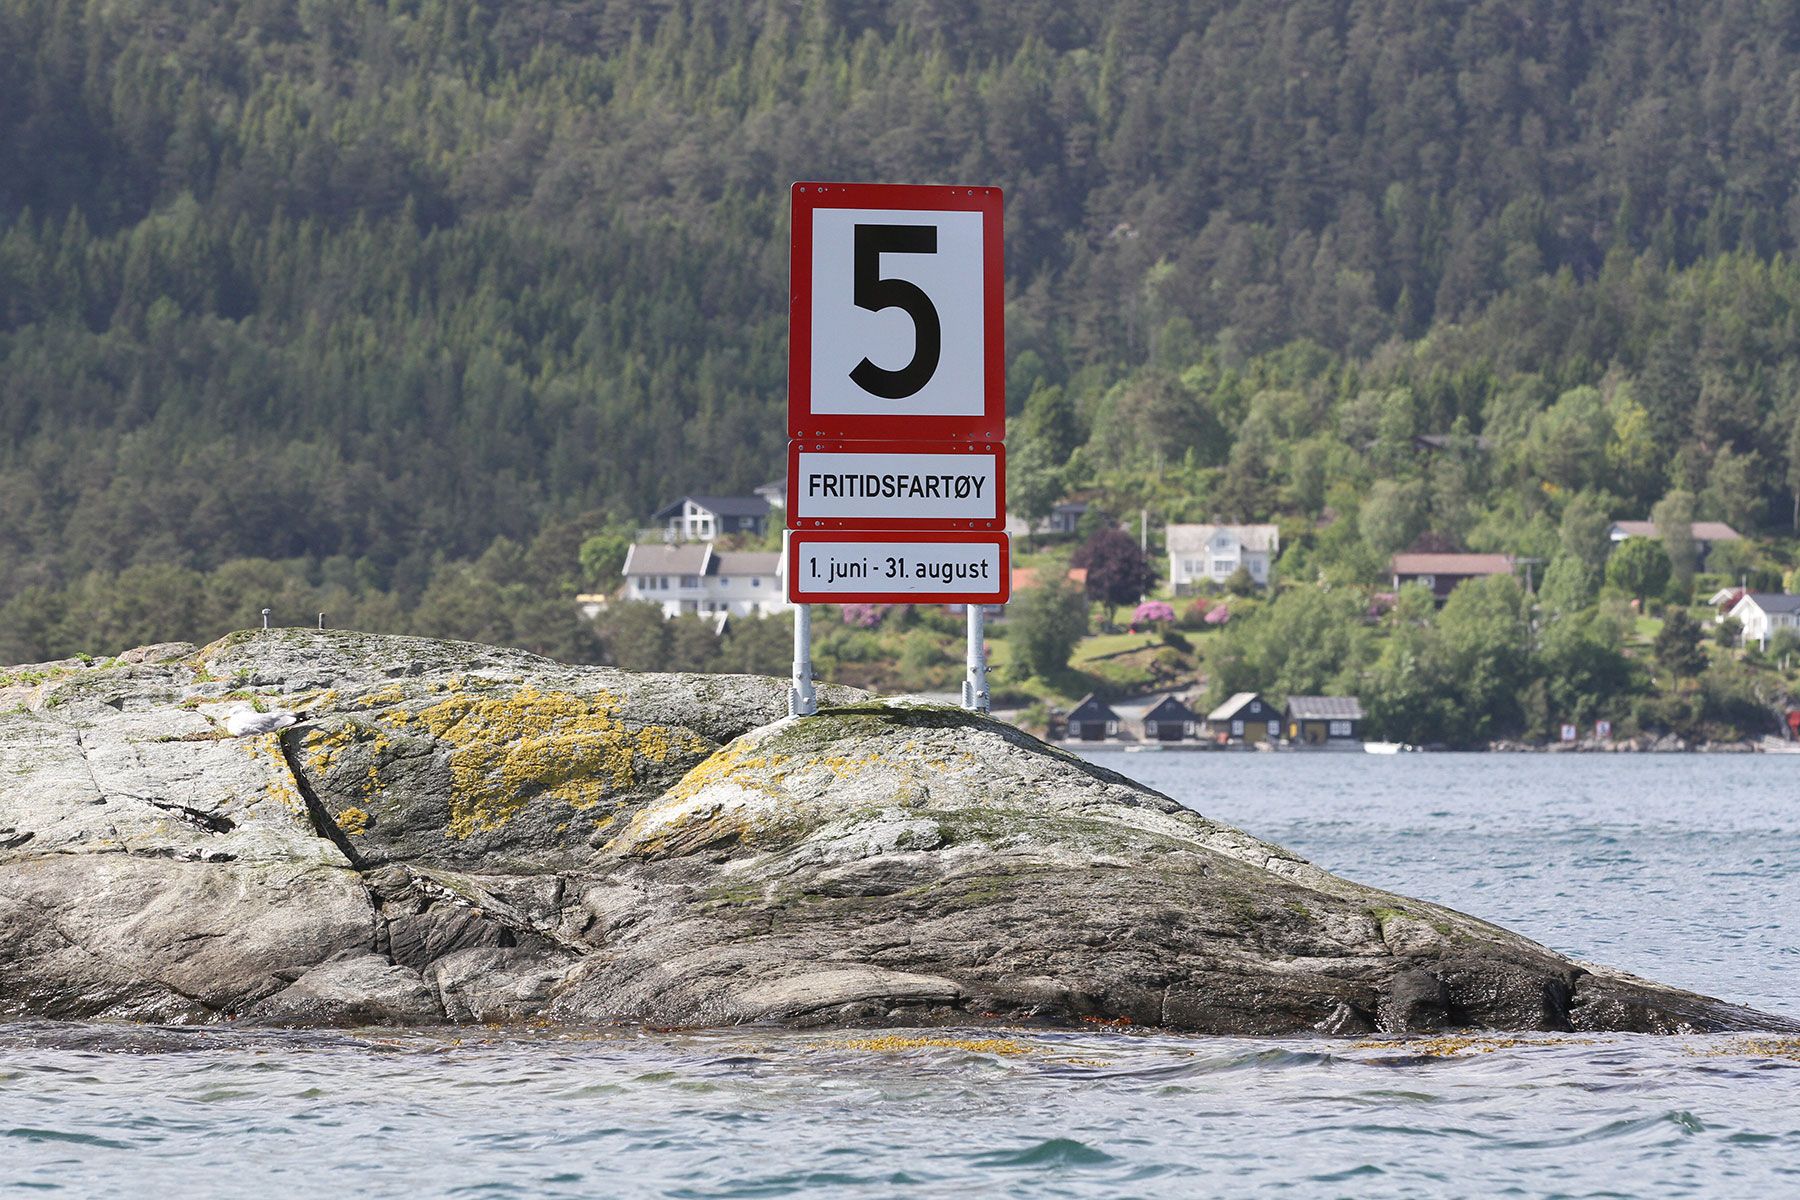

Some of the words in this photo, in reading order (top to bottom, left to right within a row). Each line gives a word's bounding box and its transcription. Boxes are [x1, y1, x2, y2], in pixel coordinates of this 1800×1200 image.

[848, 223, 941, 400] 5
[809, 474, 986, 499] FRITIDSFARTØY
[810, 557, 821, 578] 1.
[828, 557, 867, 584] juni
[885, 557, 909, 579] 31.
[915, 558, 989, 584] august
